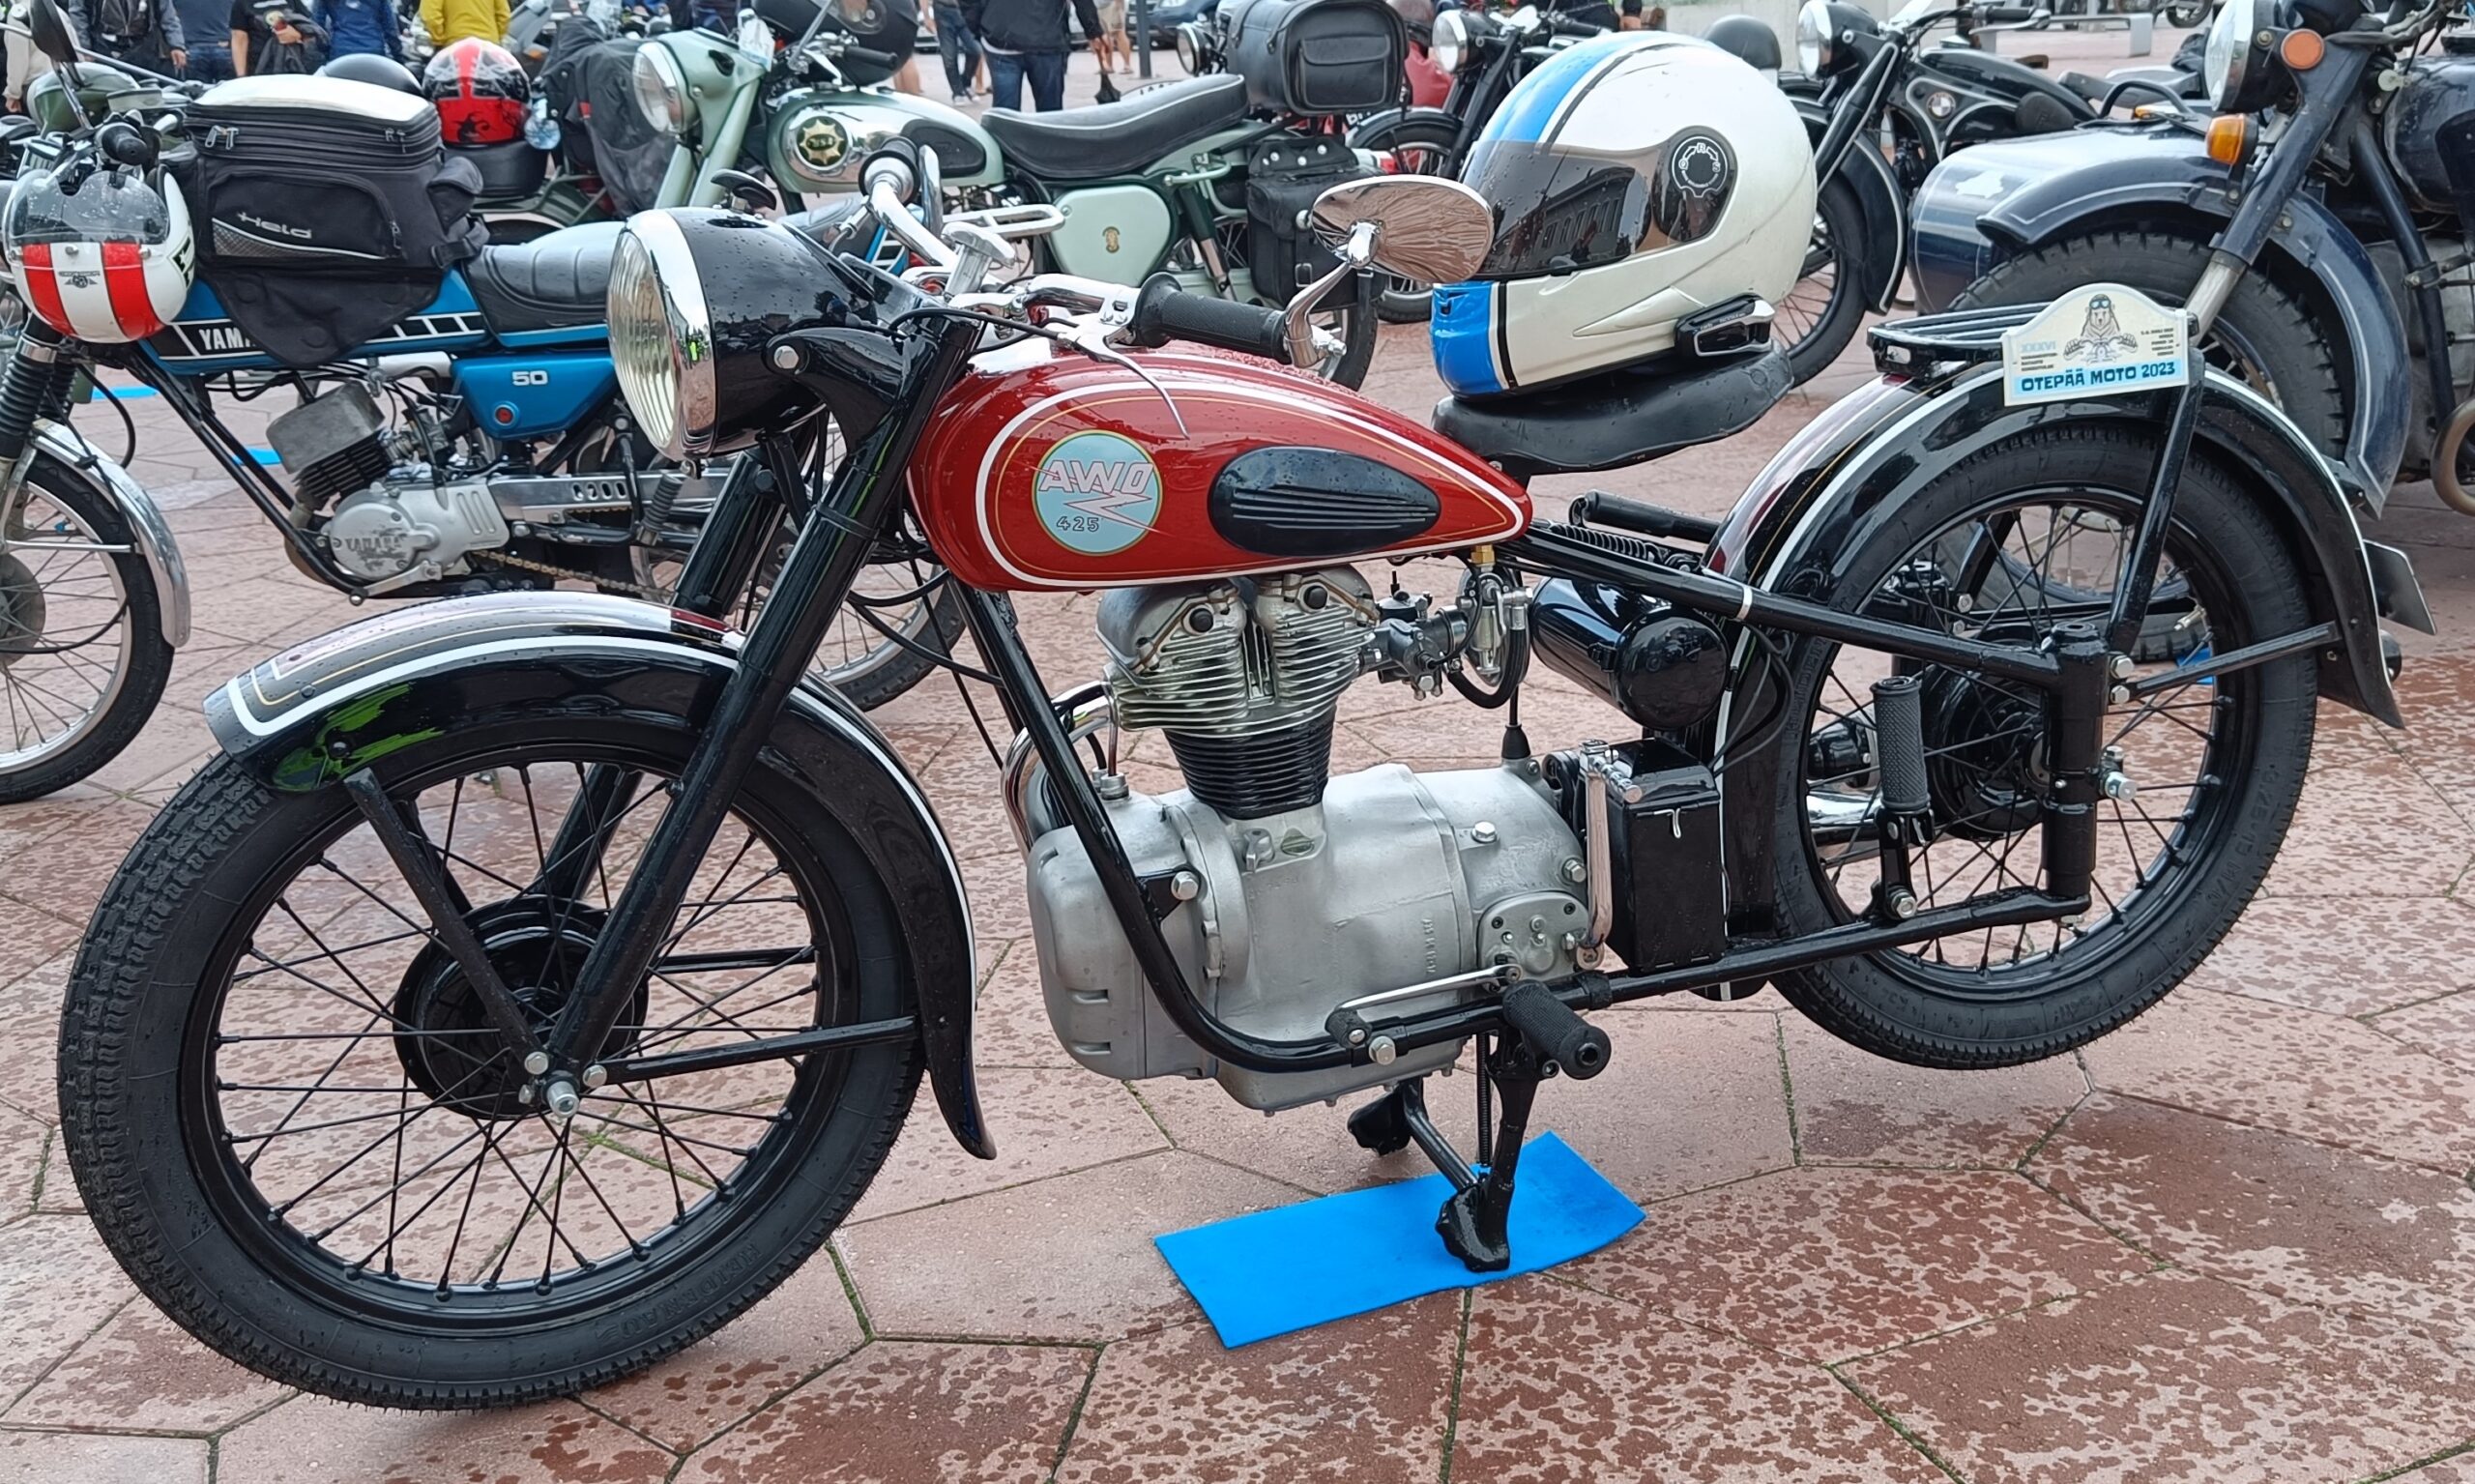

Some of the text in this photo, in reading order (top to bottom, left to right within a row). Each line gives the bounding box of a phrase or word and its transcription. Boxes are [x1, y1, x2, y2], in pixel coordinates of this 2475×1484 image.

[237, 211, 312, 239] Held
[198, 327, 256, 351] YAM
[511, 370, 548, 386] 50
[2022, 362, 2175, 392] OTEPÄÄ MOTO 2023
[1038, 459, 1154, 494] AWO
[1057, 515, 1100, 532] 425
[621, 1242, 762, 1338] HEIDENAU
